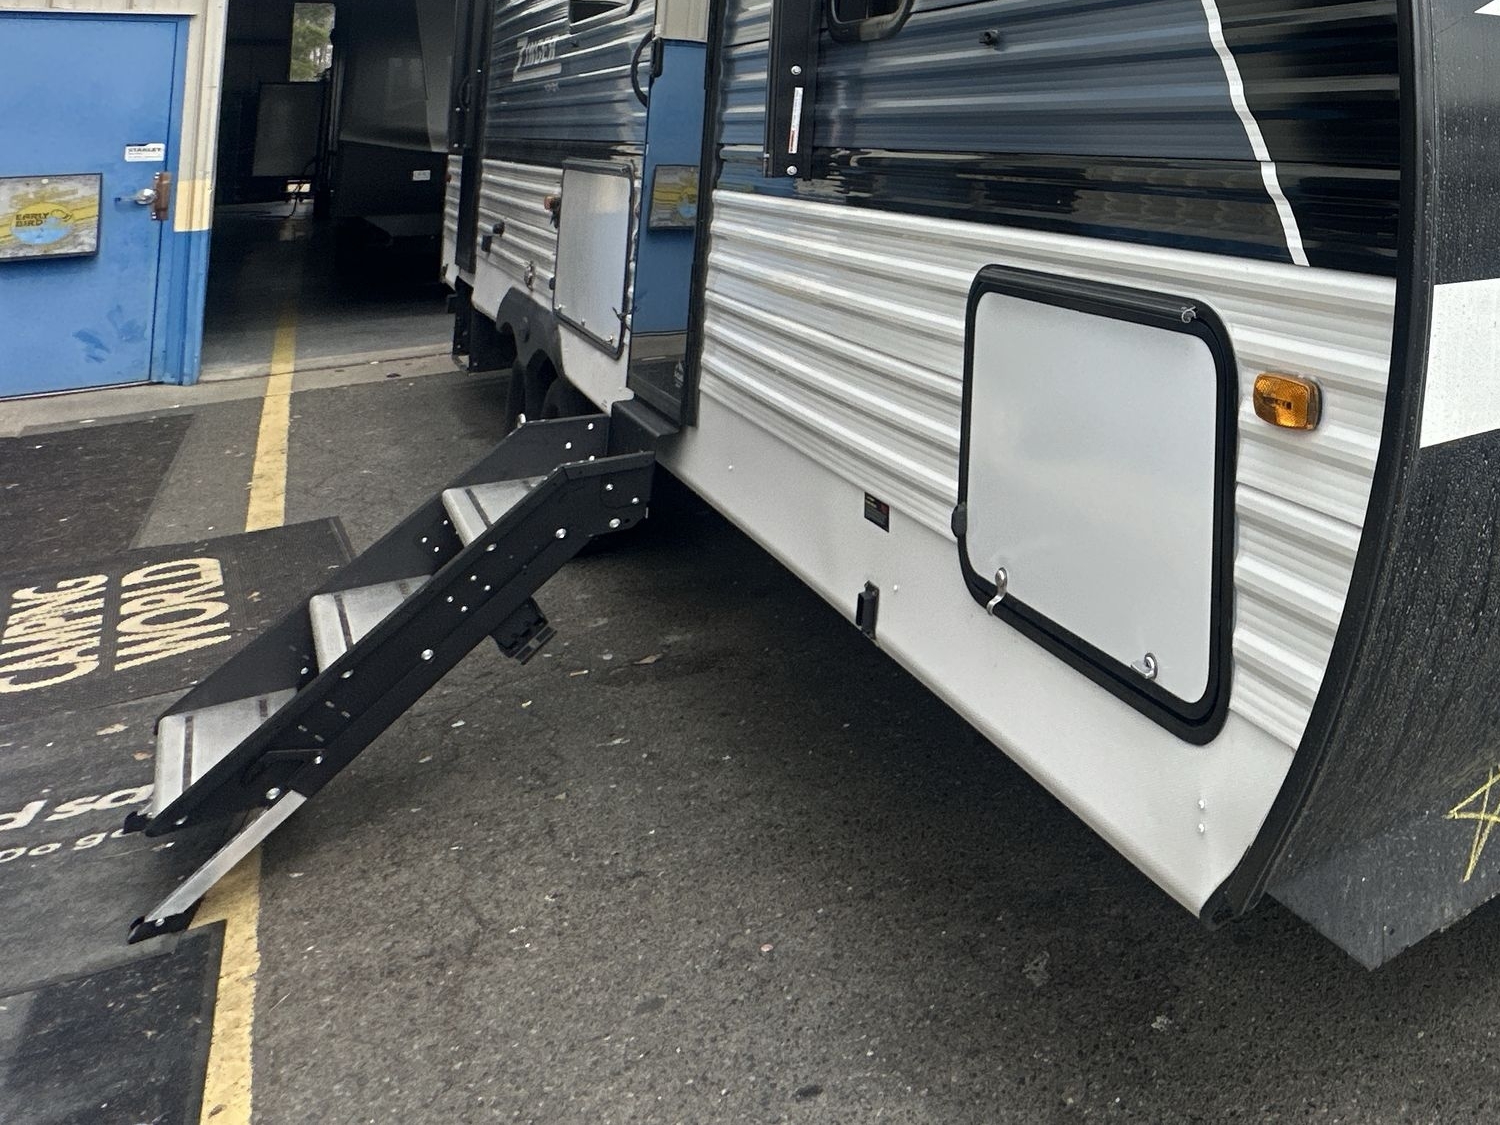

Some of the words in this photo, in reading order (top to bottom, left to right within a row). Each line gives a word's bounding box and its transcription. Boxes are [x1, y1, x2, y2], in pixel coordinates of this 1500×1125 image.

[512, 35, 561, 82] ZINGER
[15, 212, 50, 221] EARLY
[15, 220, 43, 228] BIRD
[0, 574, 109, 693] CAMPING
[114, 557, 232, 671] WORLD
